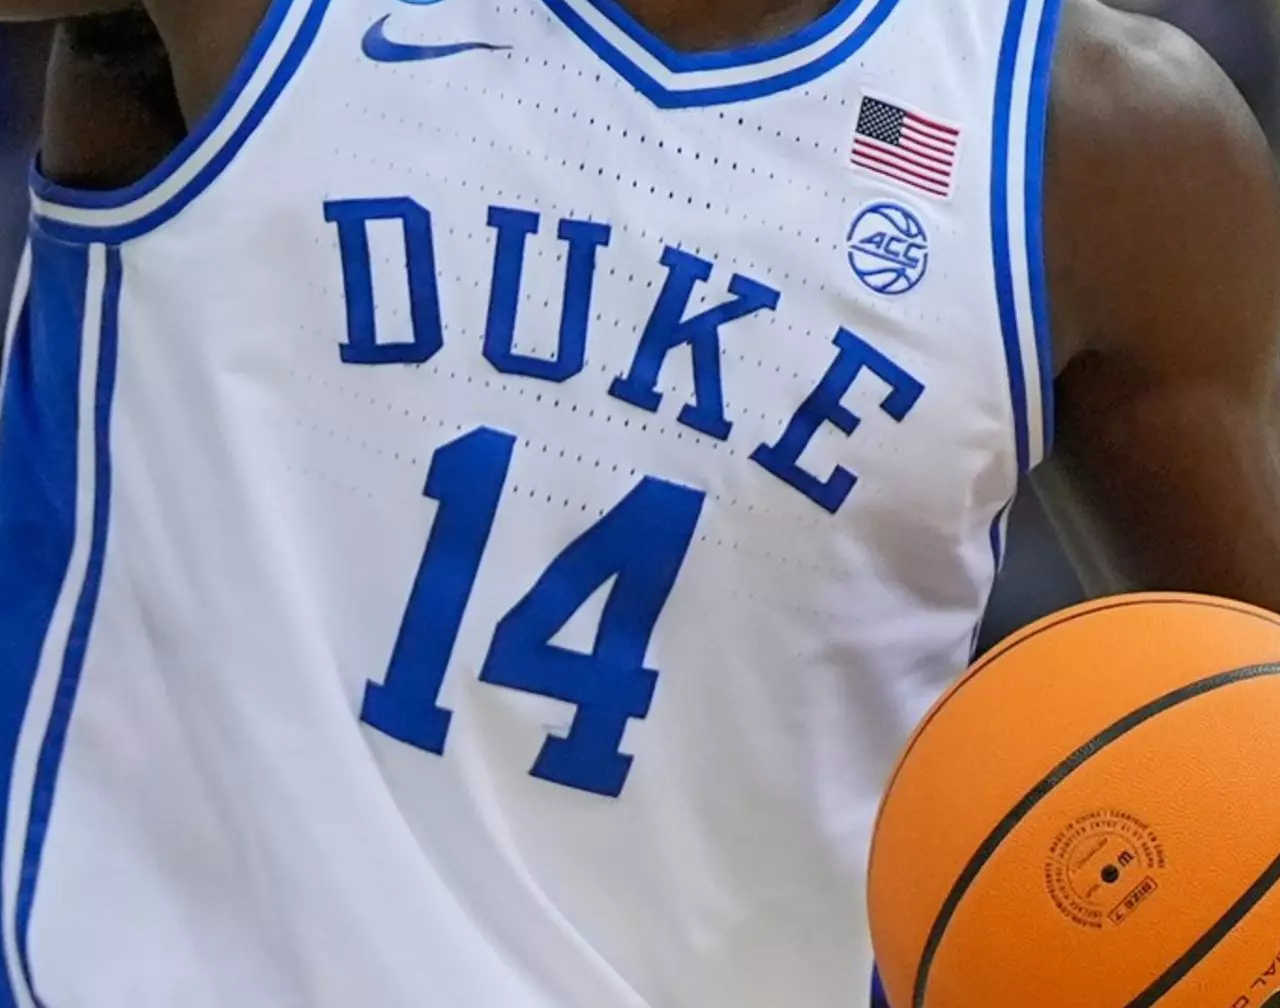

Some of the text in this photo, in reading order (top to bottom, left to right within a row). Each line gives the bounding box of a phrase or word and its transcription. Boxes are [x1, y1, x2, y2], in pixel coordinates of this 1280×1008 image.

[323, 196, 926, 515] DUKE
[860, 231, 927, 265] ACC
[360, 425, 707, 798] 14
